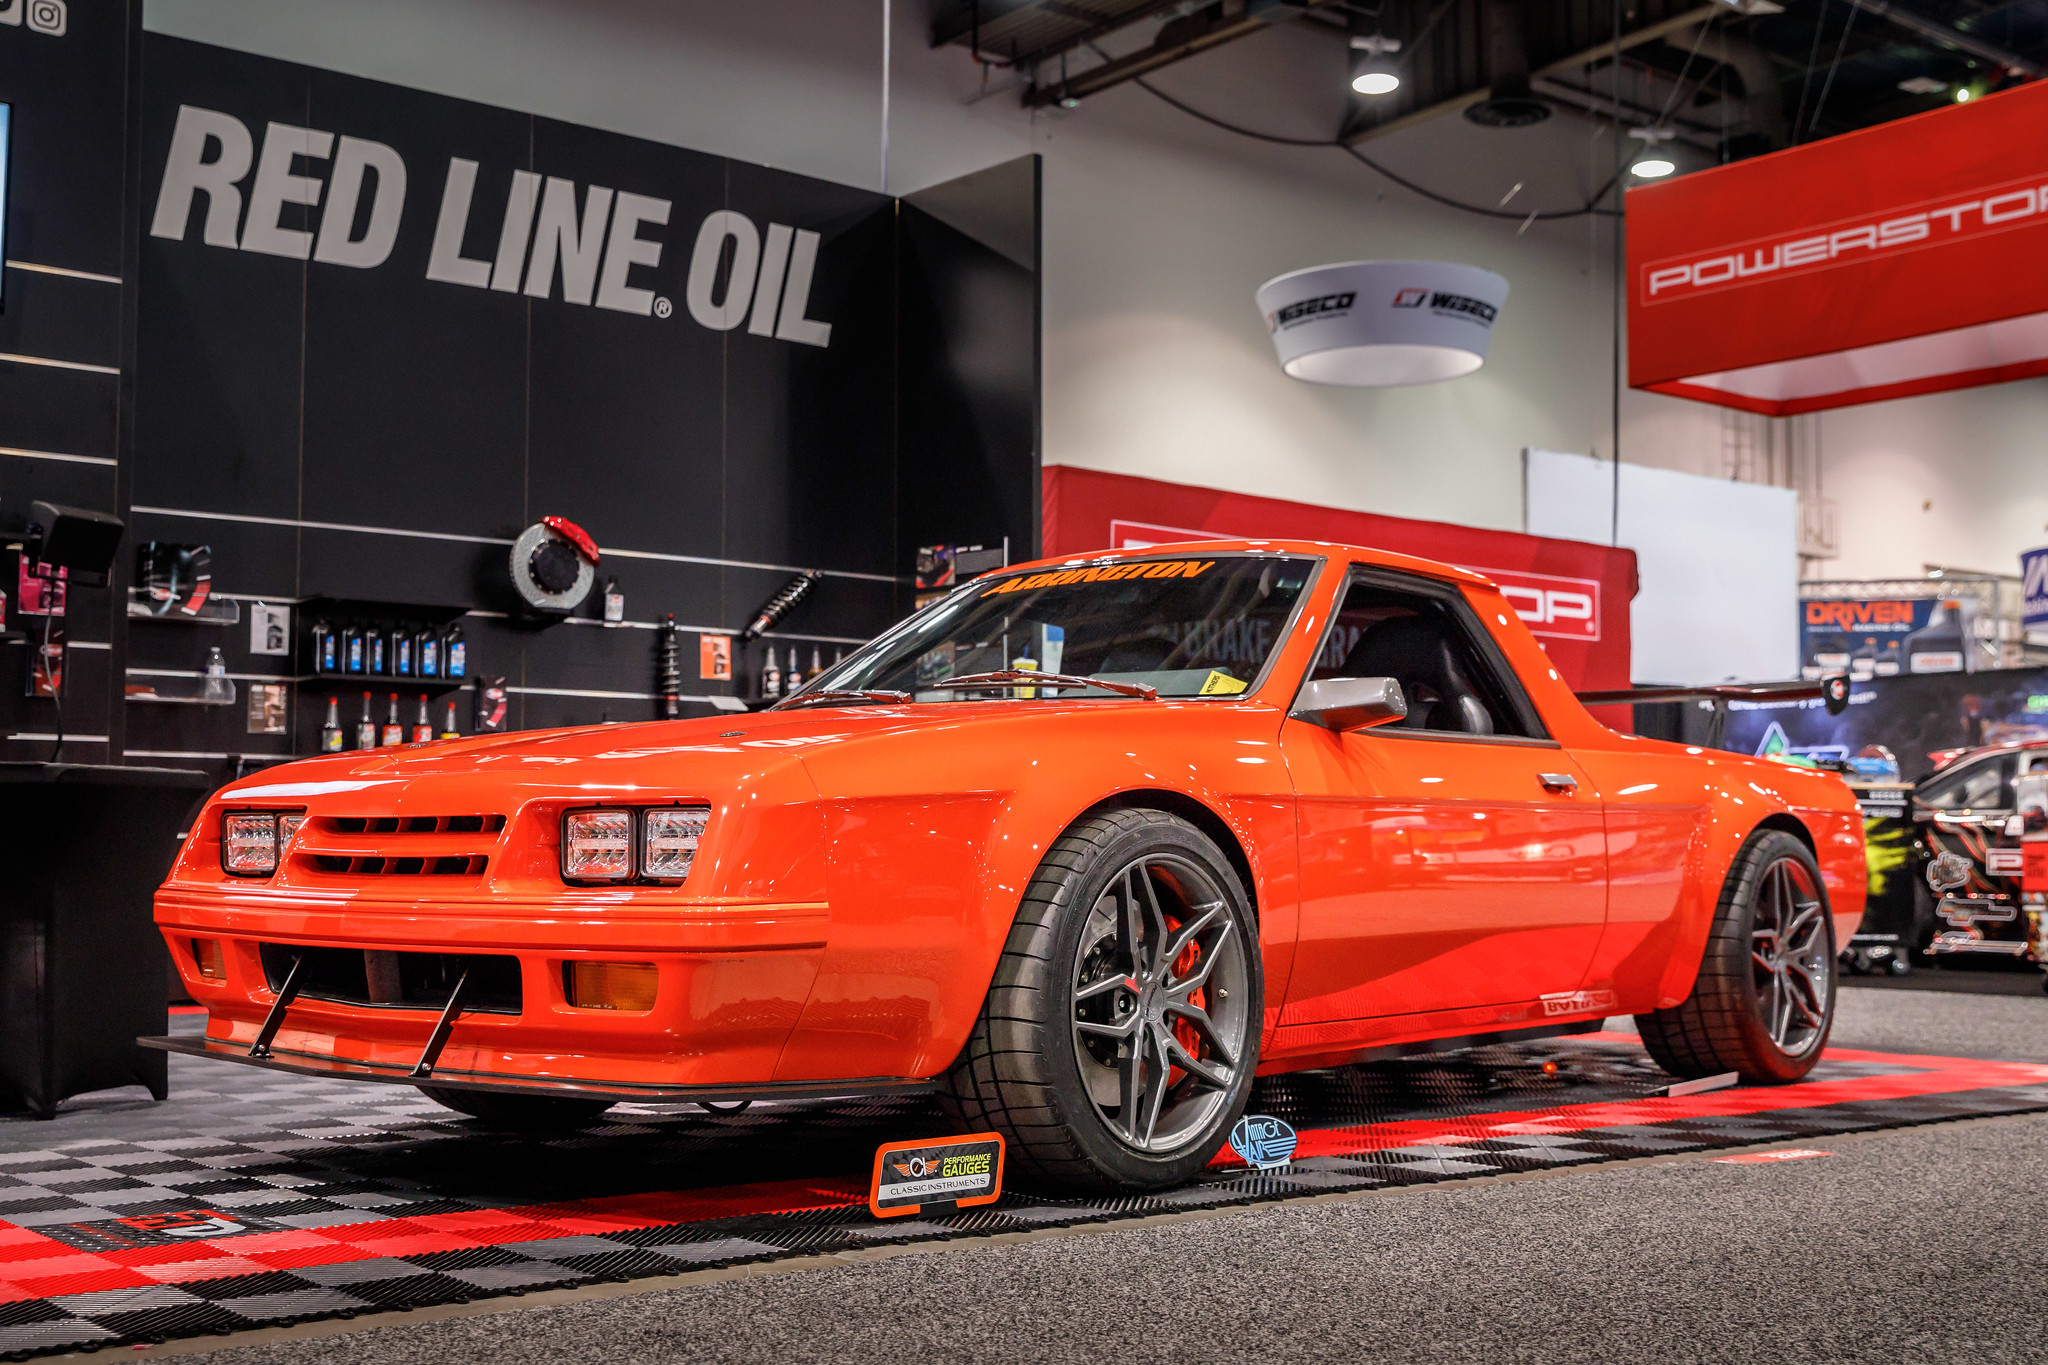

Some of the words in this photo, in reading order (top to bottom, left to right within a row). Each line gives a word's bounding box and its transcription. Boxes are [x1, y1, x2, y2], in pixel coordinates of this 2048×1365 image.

[150, 104, 407, 270] RED
[425, 157, 673, 317] LINE
[687, 210, 833, 348] OIL
[1649, 185, 2048, 296] POWERSTO
[980, 561, 1216, 598] ARRINGTON
[1806, 601, 1914, 631] DRIVEN
[942, 1161, 990, 1177] GAUGES
[943, 1153, 992, 1165] PERFORMANCE
[890, 1184, 927, 1196] CLASSIC
[928, 1177, 986, 1191] INSTRUMENTS
